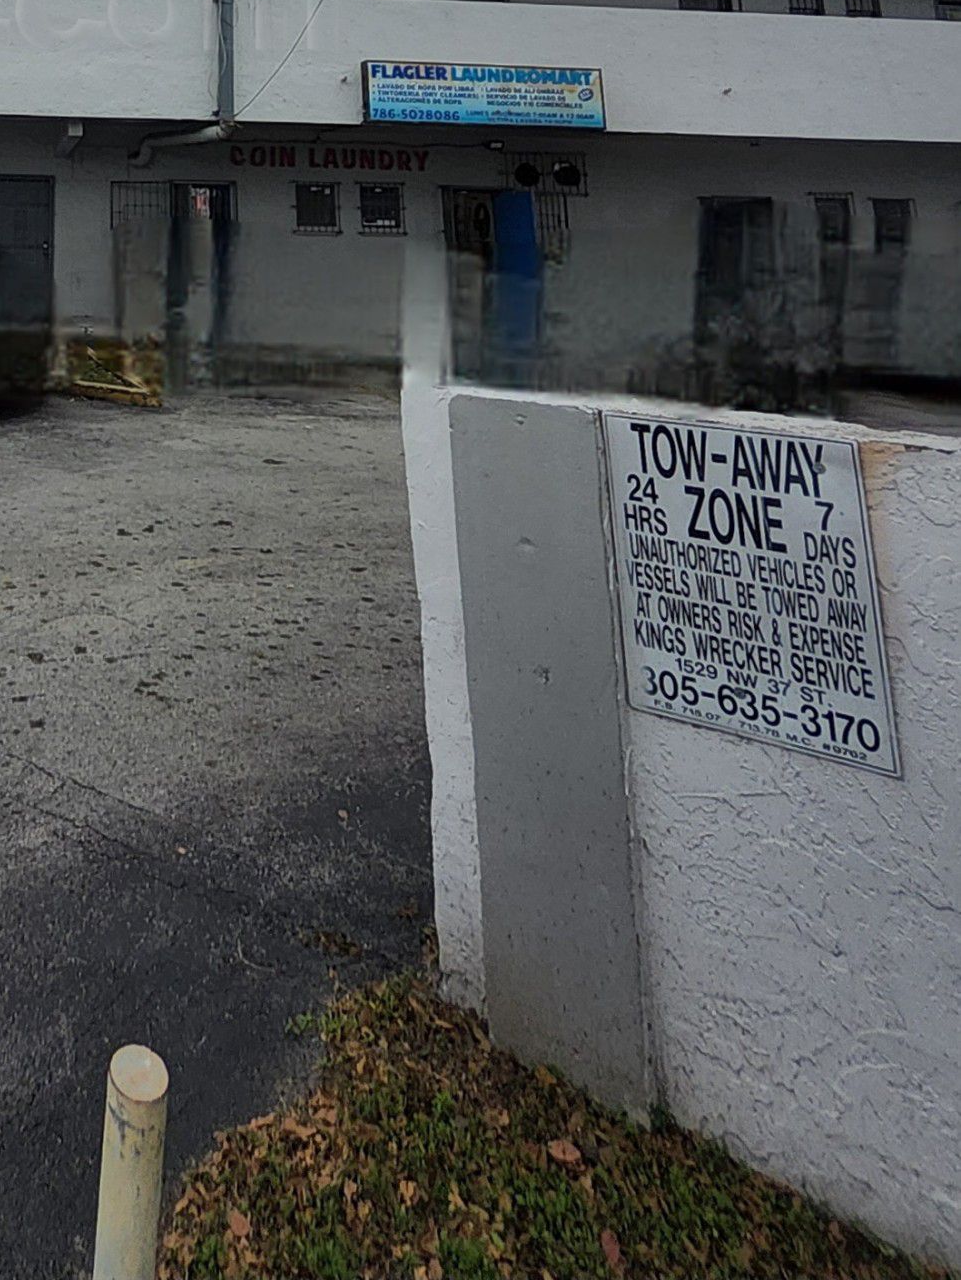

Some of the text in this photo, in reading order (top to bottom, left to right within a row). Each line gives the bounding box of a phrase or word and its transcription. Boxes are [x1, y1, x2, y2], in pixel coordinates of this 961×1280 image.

[370, 63, 592, 86] FLAGLER LAUNDROMART
[372, 108, 460, 120] 786-5028086
[229, 145, 430, 172] COIN LAUNDRY
[629, 422, 824, 499] TOW-AWAY
[626, 473, 659, 505] 24
[623, 502, 669, 536] HRS
[684, 484, 788, 554] ZONE
[814, 500, 834, 532] 7
[629, 532, 858, 600] UNAUTHORIZED VEHICLES OR
[803, 531, 857, 569] DAYS
[625, 559, 867, 633] VESSELS WILL BE TOWED AWAY
[637, 591, 867, 665] AT OWNERS RISK & EXPENSE
[633, 618, 876, 701] KINGS WRECKER SERVICE
[674, 657, 834, 708] 1529 NW 37 ST.
[640, 664, 881, 753] 305-635-3170
[785, 732, 816, 748] M.C.
[821, 742, 869, 761] #0702
